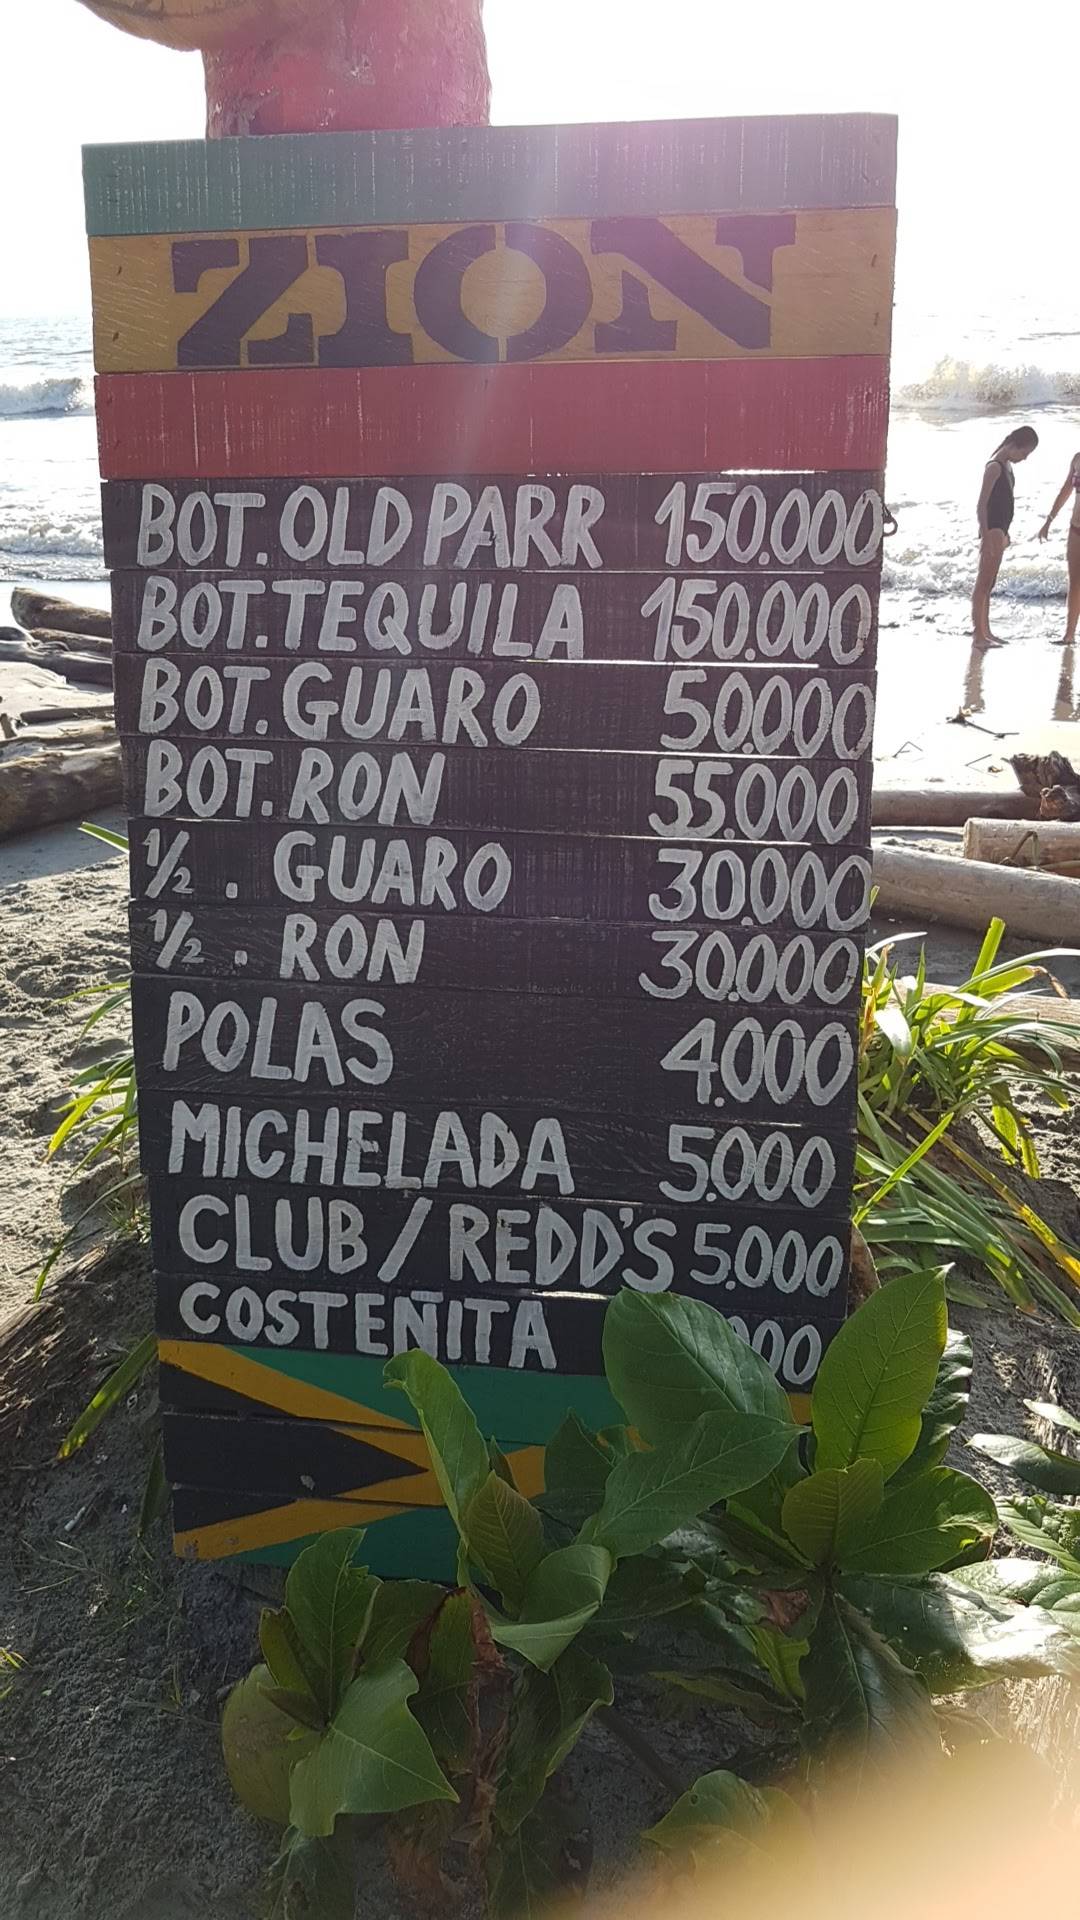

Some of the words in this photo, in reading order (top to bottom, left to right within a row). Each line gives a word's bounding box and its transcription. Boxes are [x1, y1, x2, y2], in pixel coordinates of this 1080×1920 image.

[172, 215, 796, 366] ZION
[137, 483, 268, 567] BOT.
[280, 485, 413, 567] OLD
[424, 482, 605, 568] PARR
[655, 481, 884, 567] 150.000
[137, 576, 268, 652] BOT.
[272, 579, 584, 660] TEQUILA
[641, 577, 872, 665] 150.000
[138, 658, 271, 735] BOT.
[283, 661, 541, 747] GUARO
[660, 669, 875, 760] 50.000
[143, 739, 274, 818] BOT.
[289, 747, 446, 826] RON
[648, 759, 859, 845] 55.000
[274, 830, 512, 913] GUARO
[648, 847, 873, 931] 30.000
[280, 913, 425, 984] RON
[639, 931, 860, 1004] 30.000
[162, 991, 394, 1086] POLAS
[660, 1017, 854, 1107] 4.000
[168, 1100, 575, 1195] MICHELADA
[659, 1124, 836, 1208] 5.000
[178, 1194, 368, 1274] CLUB
[449, 1203, 677, 1293] REDD'S
[690, 1223, 844, 1298] 5.000
[179, 1281, 557, 1370] COSTEÑITA
